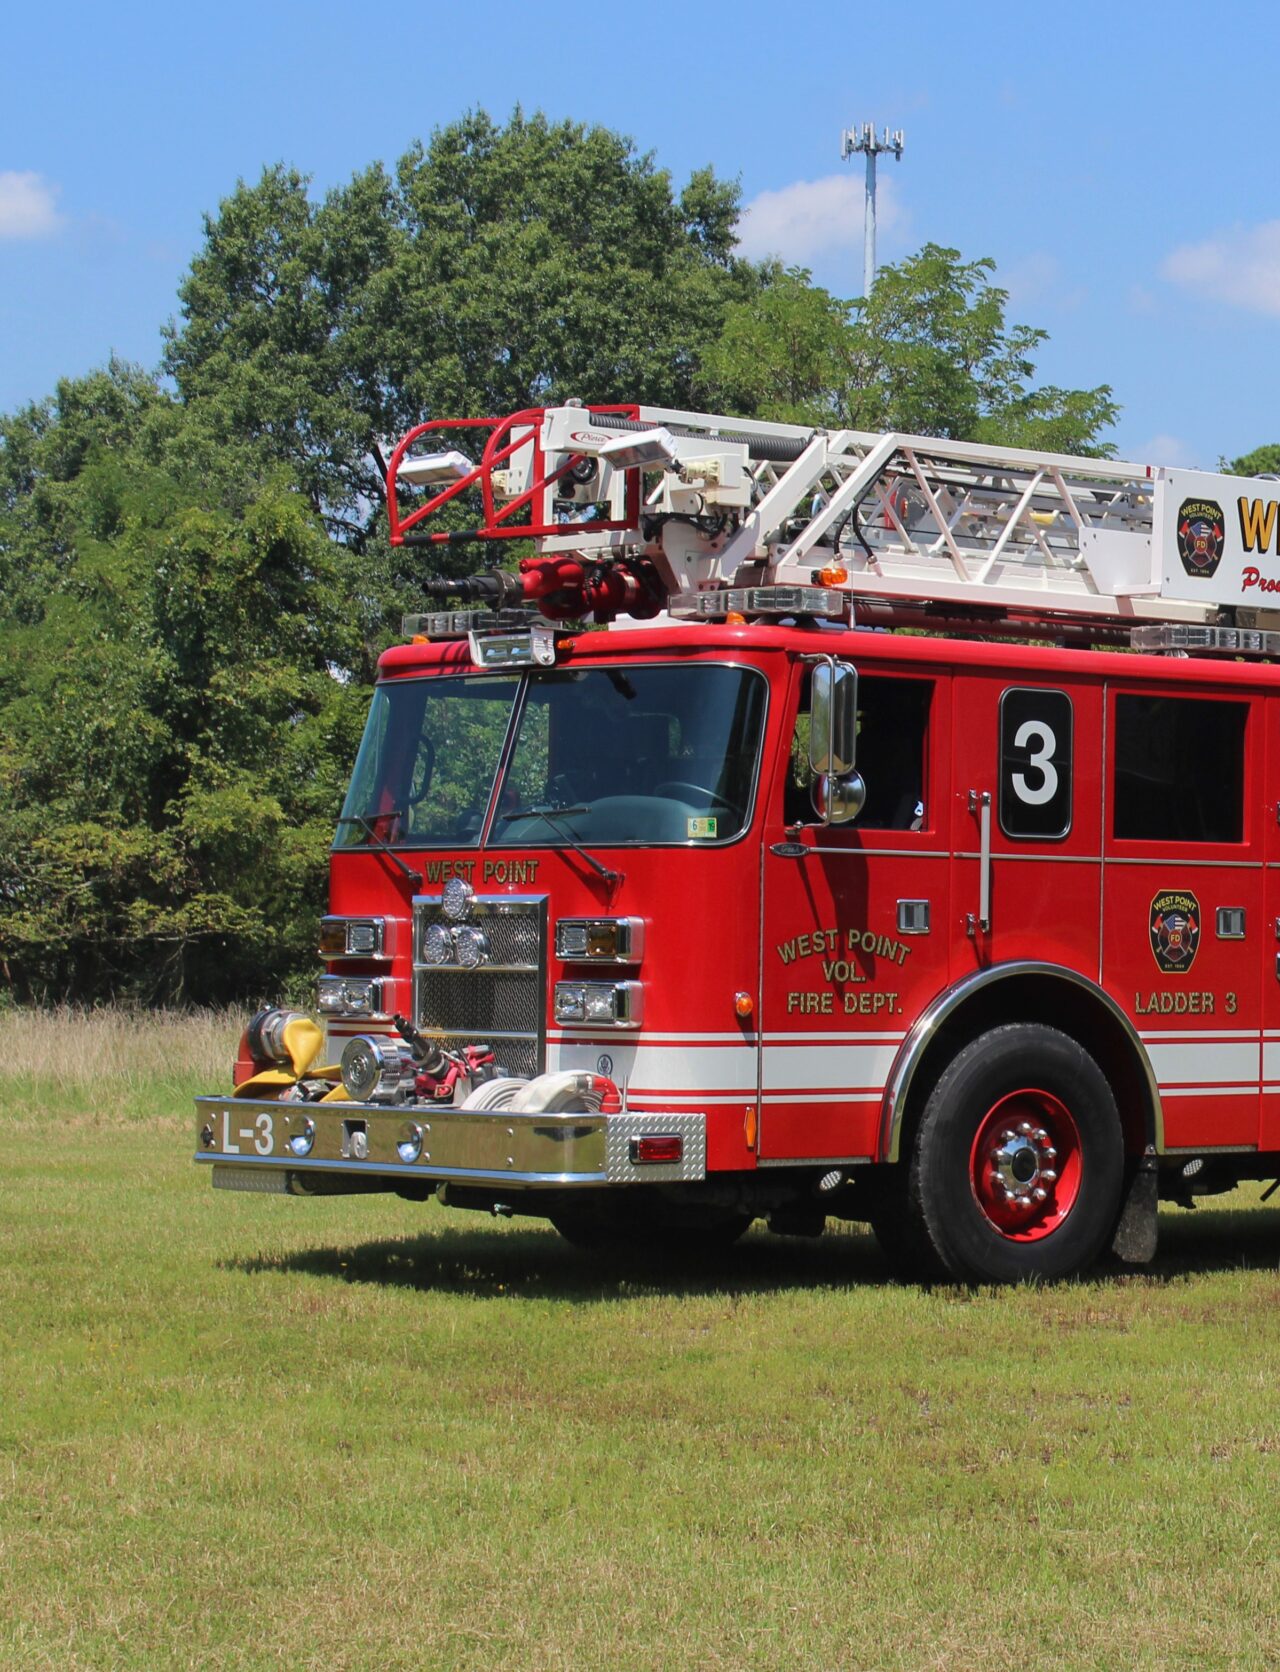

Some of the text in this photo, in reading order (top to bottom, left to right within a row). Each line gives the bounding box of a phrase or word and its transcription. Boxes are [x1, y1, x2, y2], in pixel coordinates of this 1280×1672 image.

[1181, 504, 1222, 519] WEST POINT
[1196, 540, 1206, 548] FD
[1011, 720, 1059, 805] 3
[425, 860, 539, 883] WEST POINT
[1153, 895, 1197, 911] WEST POINT
[777, 928, 912, 966] WEST POINT
[1170, 934, 1181, 942] FD
[822, 960, 867, 982] VOL.
[787, 992, 903, 1014] FIRE DEPT.
[1135, 992, 1238, 1014] LADDER 3
[223, 1111, 274, 1155] L-3
